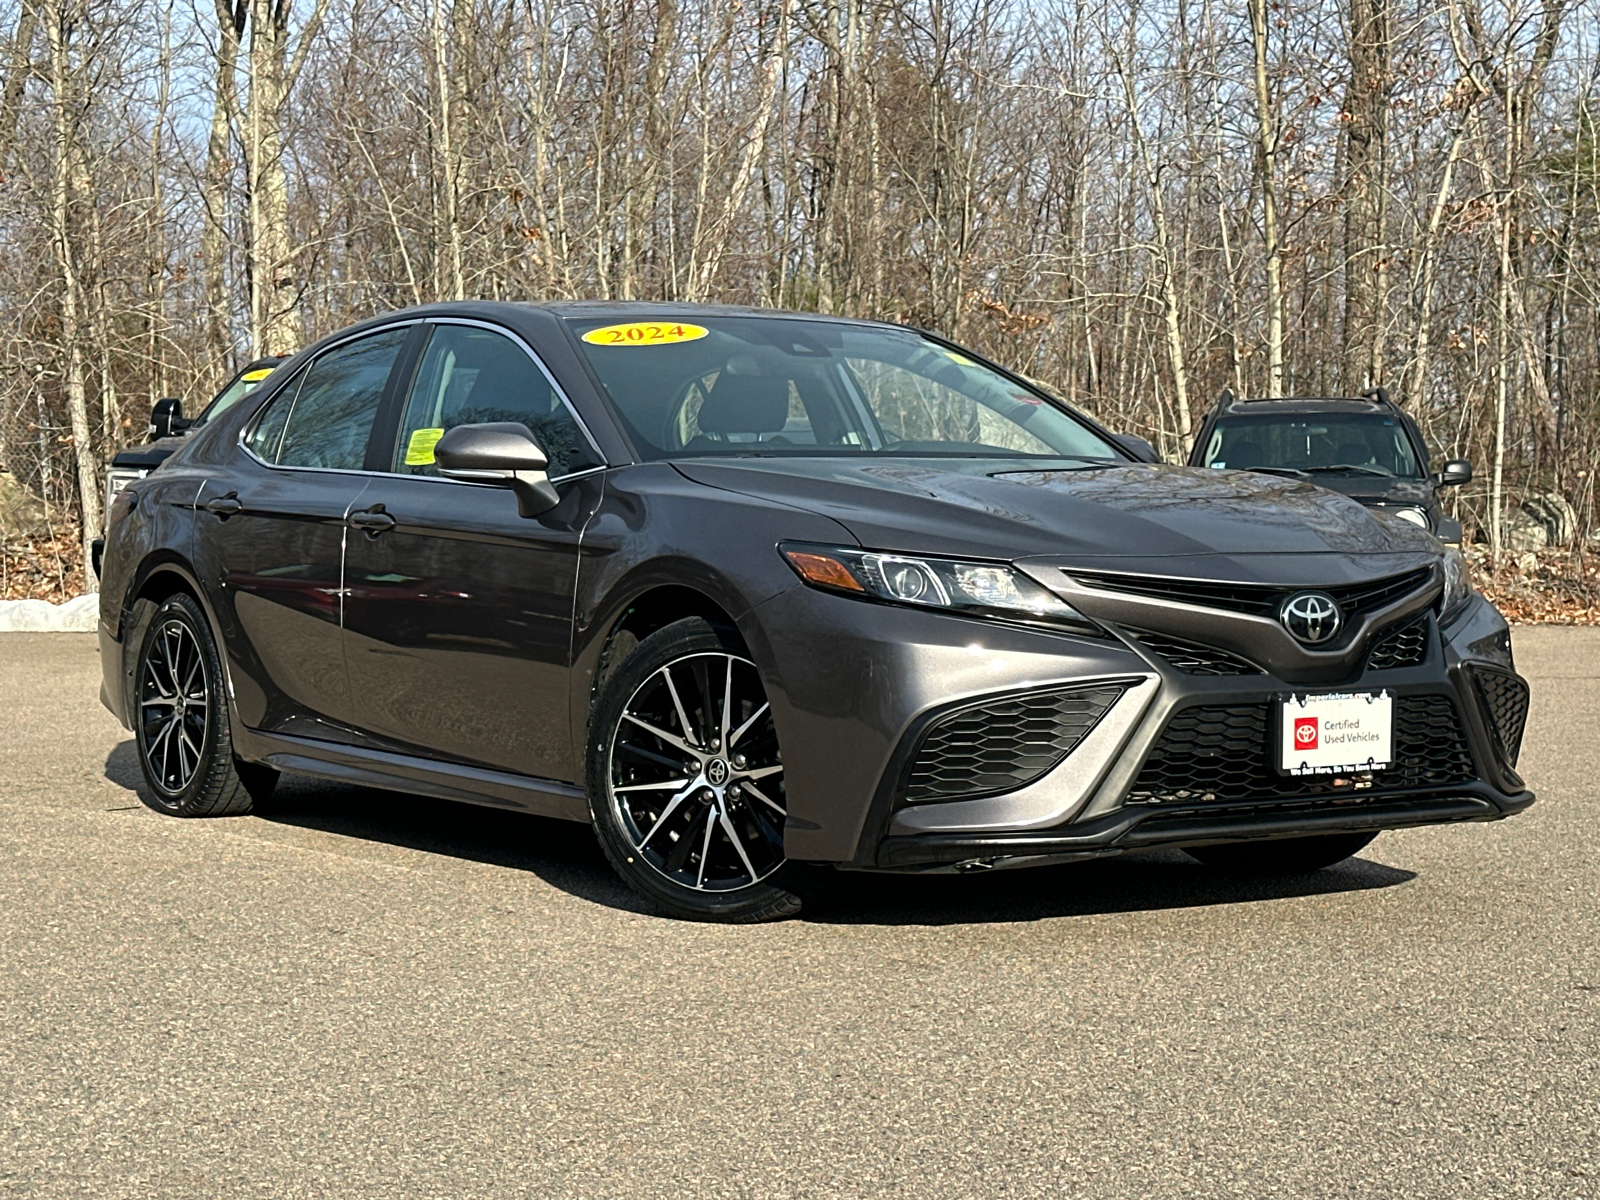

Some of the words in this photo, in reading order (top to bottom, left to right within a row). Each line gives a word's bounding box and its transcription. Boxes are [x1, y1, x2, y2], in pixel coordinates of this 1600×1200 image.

[606, 325, 686, 343] 2024
[1324, 719, 1360, 730] Certified
[1324, 733, 1345, 744] Used
[1346, 731, 1380, 743] Vehicles
